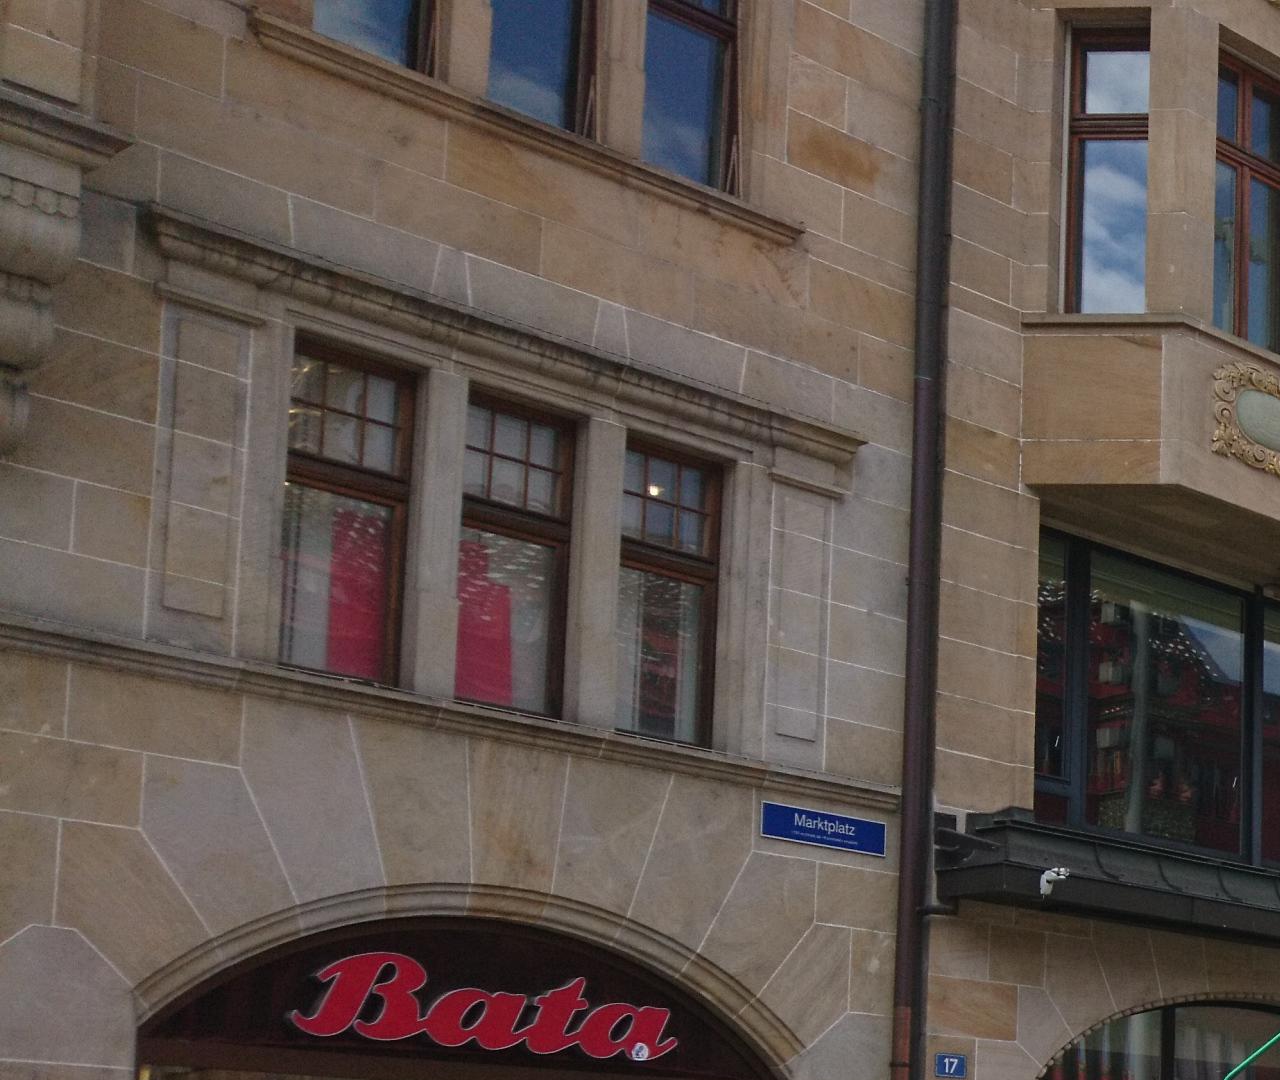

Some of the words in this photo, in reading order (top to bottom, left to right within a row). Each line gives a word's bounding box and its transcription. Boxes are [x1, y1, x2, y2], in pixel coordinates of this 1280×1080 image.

[794, 813, 856, 836] Marktplatz
[290, 951, 678, 1062] Bata
[943, 1058, 958, 1074] 17
